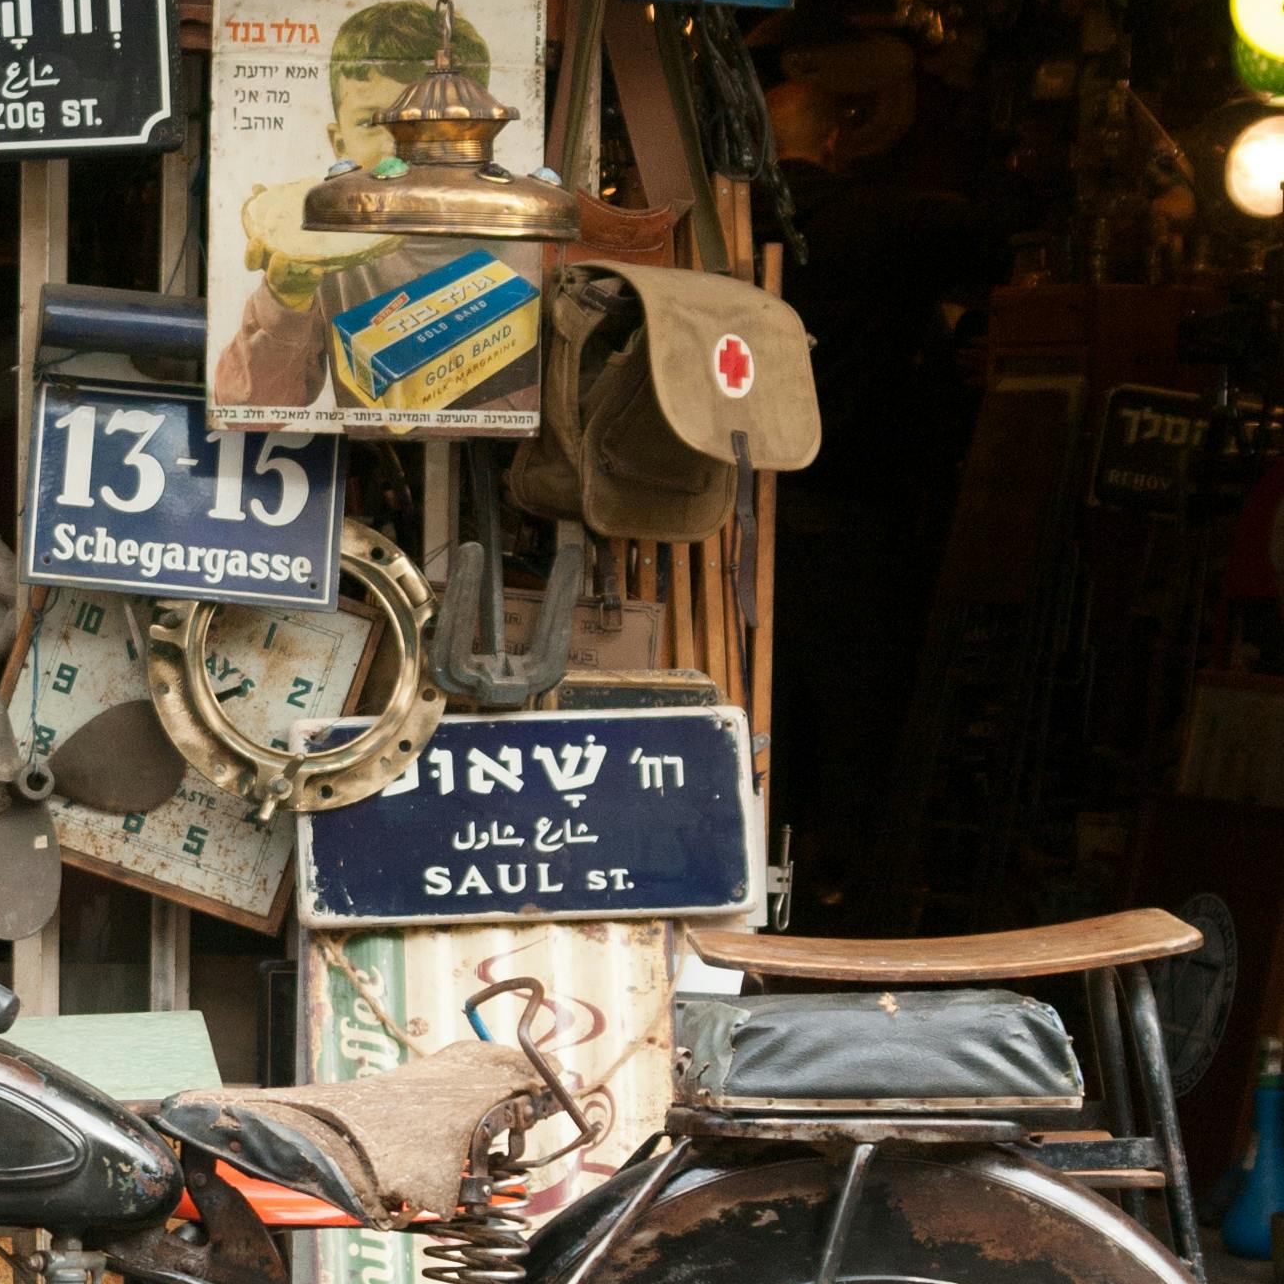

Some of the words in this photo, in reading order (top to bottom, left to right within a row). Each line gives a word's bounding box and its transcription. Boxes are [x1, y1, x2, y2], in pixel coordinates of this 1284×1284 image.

[225, 19, 266, 44] בנד
[270, 18, 320, 44] גולד
[2, 58, 60, 98] شارع
[233, 64, 279, 80] יודעת
[285, 64, 319, 80] אמא
[234, 87, 261, 104] אני
[266, 89, 290, 104] מה
[62, 98, 103, 127] ST.
[232, 107, 284, 132] אוהב!
[417, 322, 449, 343] GOLD
[454, 300, 489, 322] BAND
[425, 354, 465, 386] GOLD
[472, 324, 512, 357] BAND
[422, 382, 451, 405] MILK
[455, 339, 517, 385] MARGARINE
[52, 522, 313, 584] Schegargasse
[75, 601, 107, 635] 10
[52, 662, 79, 695] 9
[286, 677, 314, 709] 2
[182, 825, 210, 857] 5
[534, 816, 599, 852] شارع
[424, 863, 565, 897] SAUL
[587, 868, 635, 892] ST.
